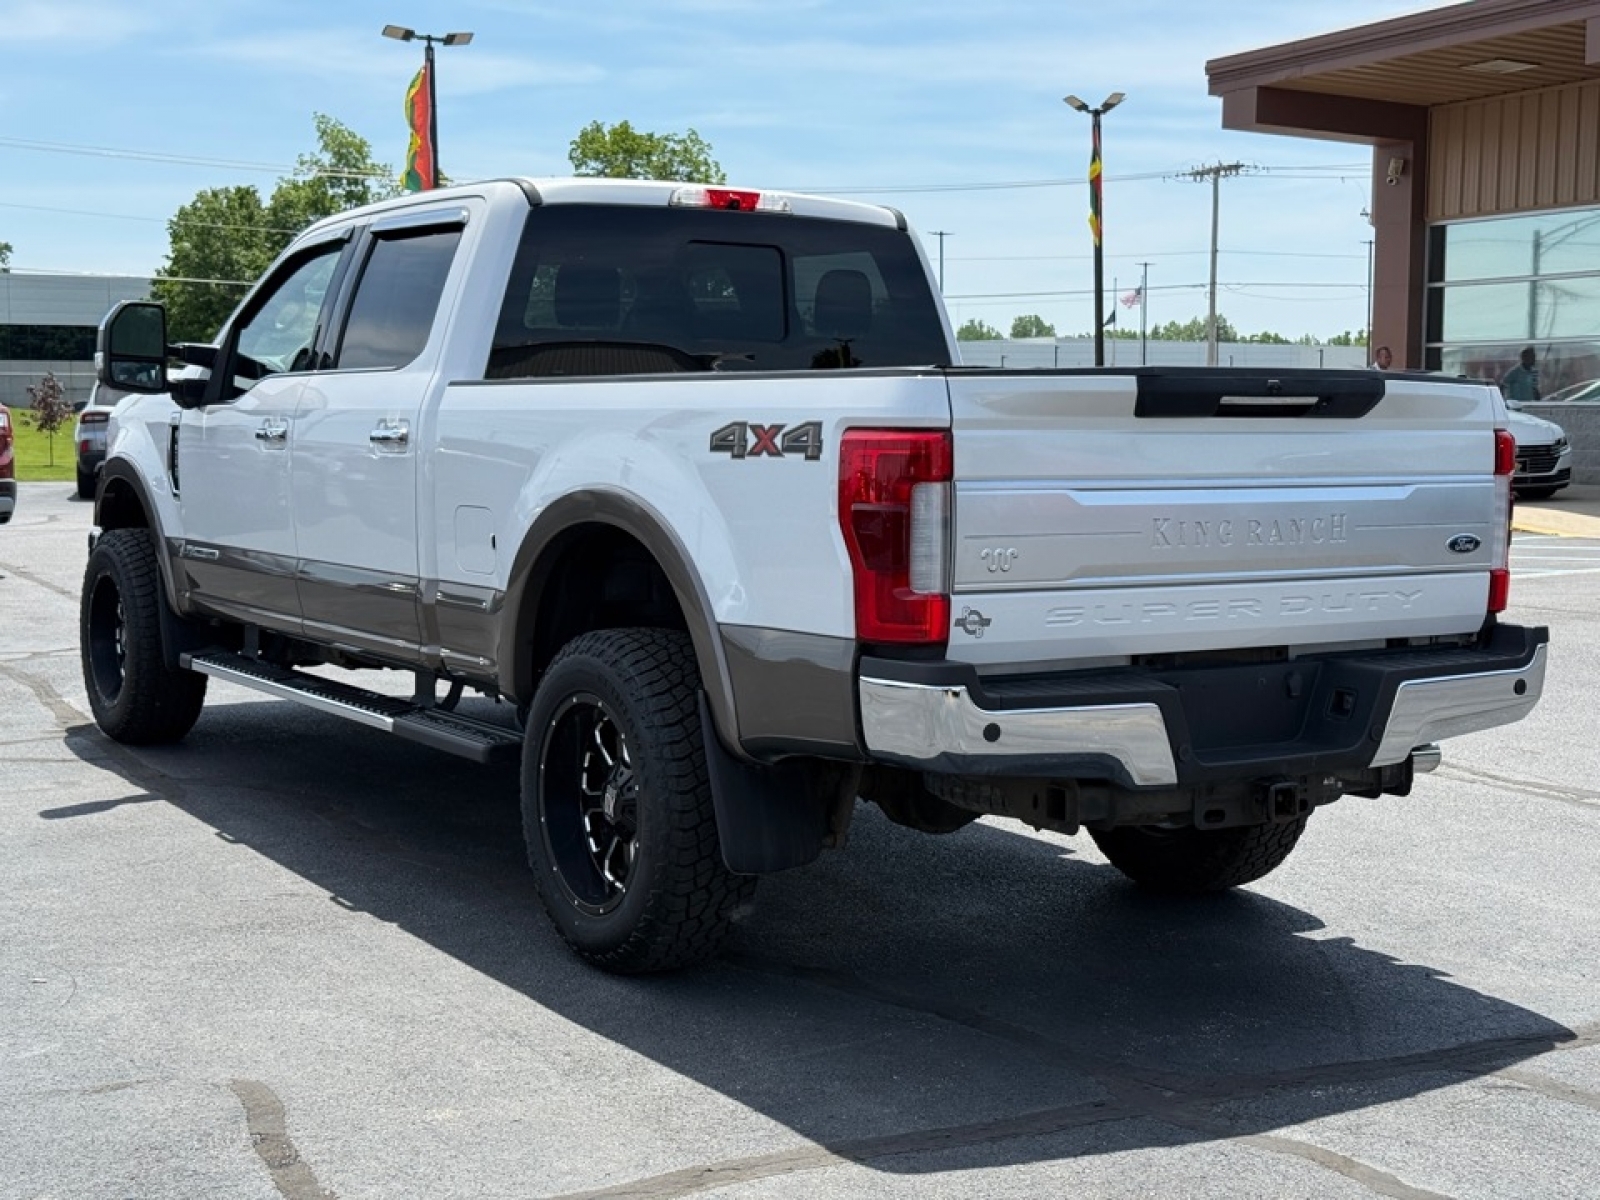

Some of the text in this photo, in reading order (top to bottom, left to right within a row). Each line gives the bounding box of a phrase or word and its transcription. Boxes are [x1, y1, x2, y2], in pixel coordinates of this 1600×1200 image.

[1151, 512, 1347, 549] KING RANCH
[1045, 589, 1424, 628] SUPER DUTY
